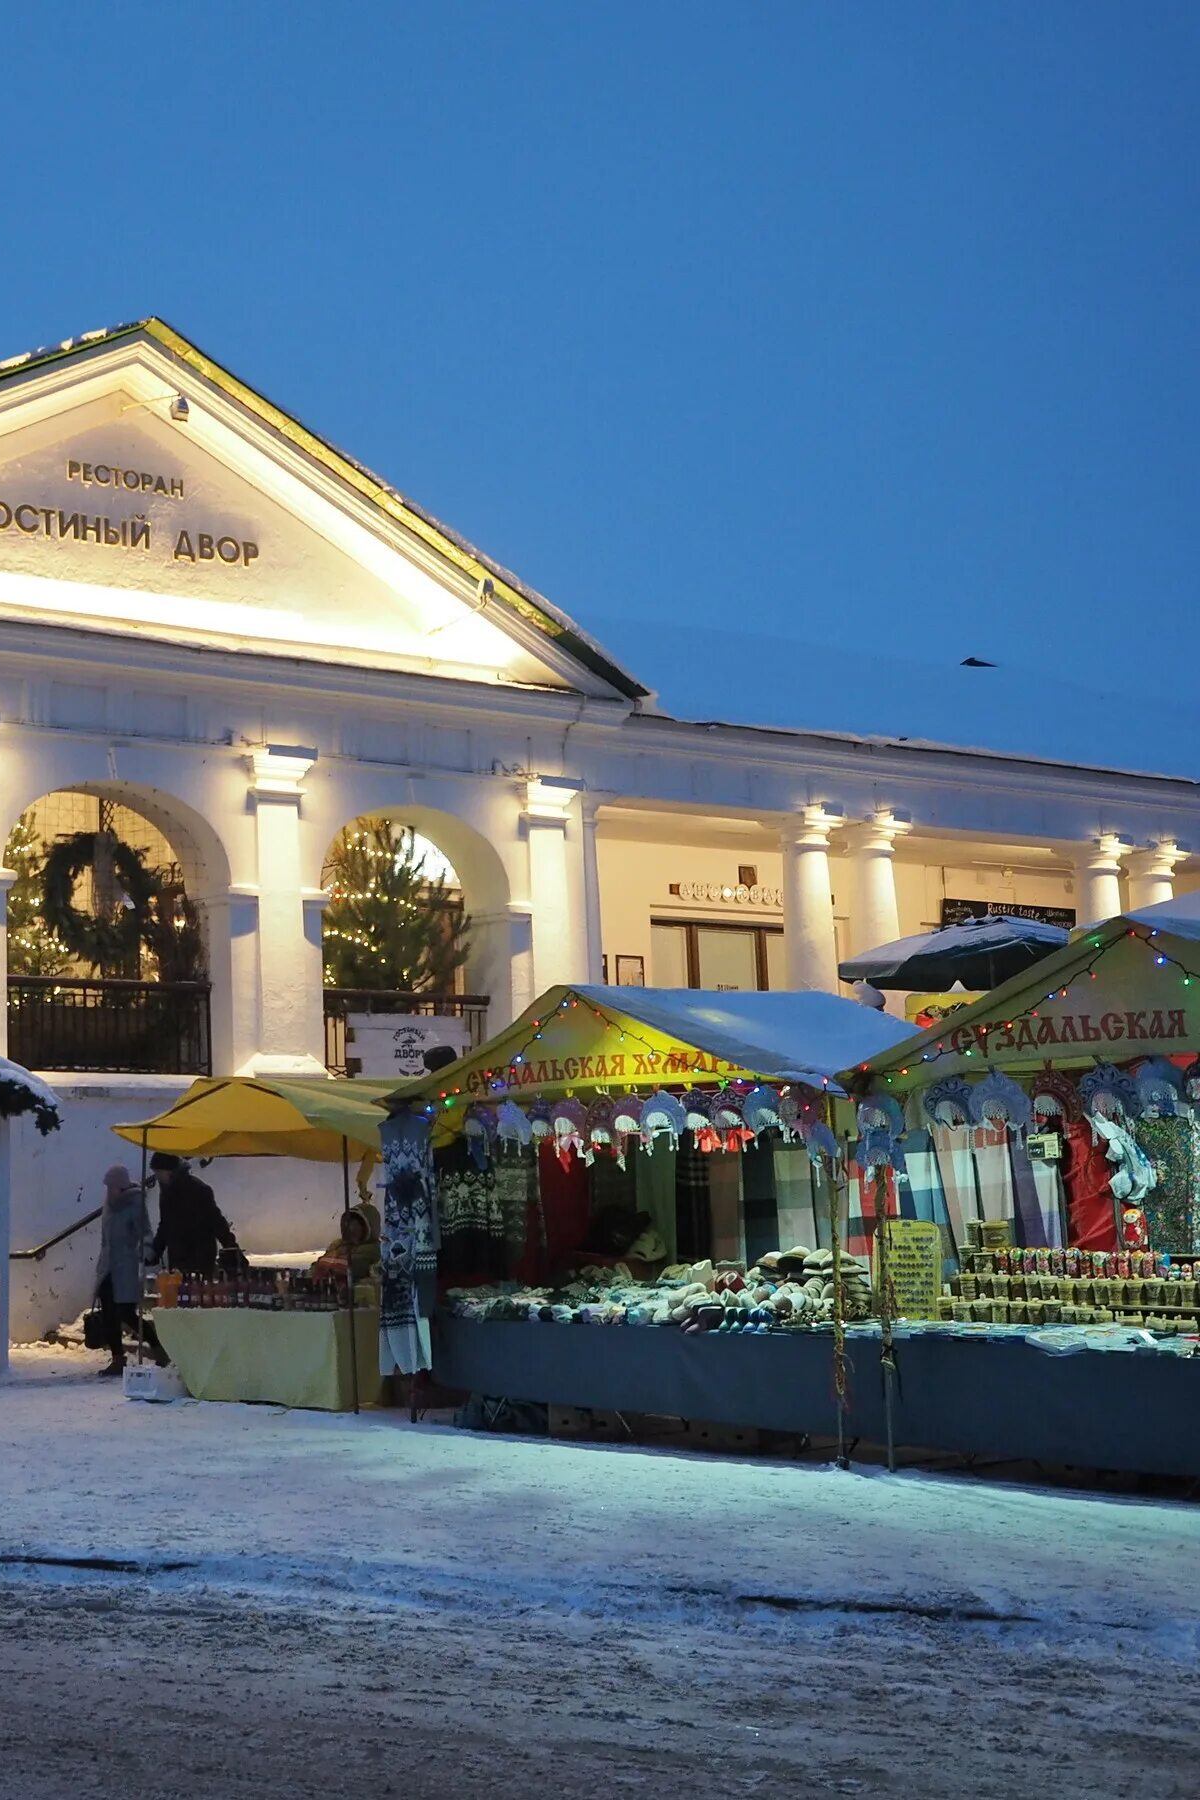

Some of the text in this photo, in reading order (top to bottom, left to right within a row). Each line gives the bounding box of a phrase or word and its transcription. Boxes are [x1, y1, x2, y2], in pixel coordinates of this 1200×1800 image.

[67, 459, 184, 498] РЕСТОРАН
[173, 529, 260, 567] ДВОР
[987, 902, 1015, 916] Rustic
[950, 1008, 1189, 1058] СУЗДАЛЬСКАЯ
[631, 1050, 745, 1076] ЯРМАР
